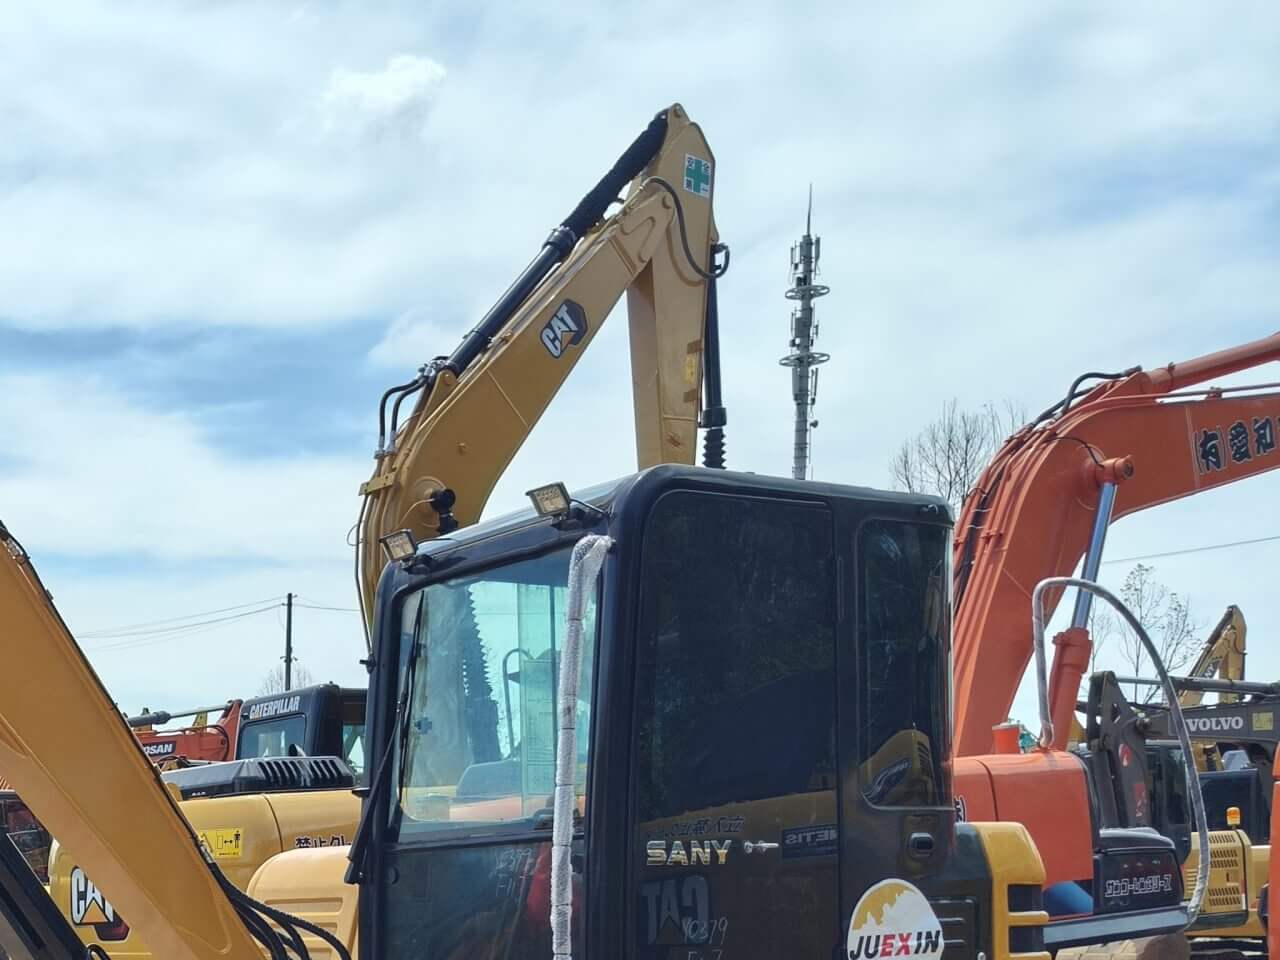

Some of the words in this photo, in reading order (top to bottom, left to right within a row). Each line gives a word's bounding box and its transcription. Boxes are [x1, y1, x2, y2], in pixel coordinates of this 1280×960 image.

[541, 303, 579, 357] CAT
[249, 696, 301, 720] CATERPILLAR
[1186, 716, 1243, 732] VOLVO
[646, 840, 732, 866] SANY
[849, 930, 941, 960] JUEXIN
